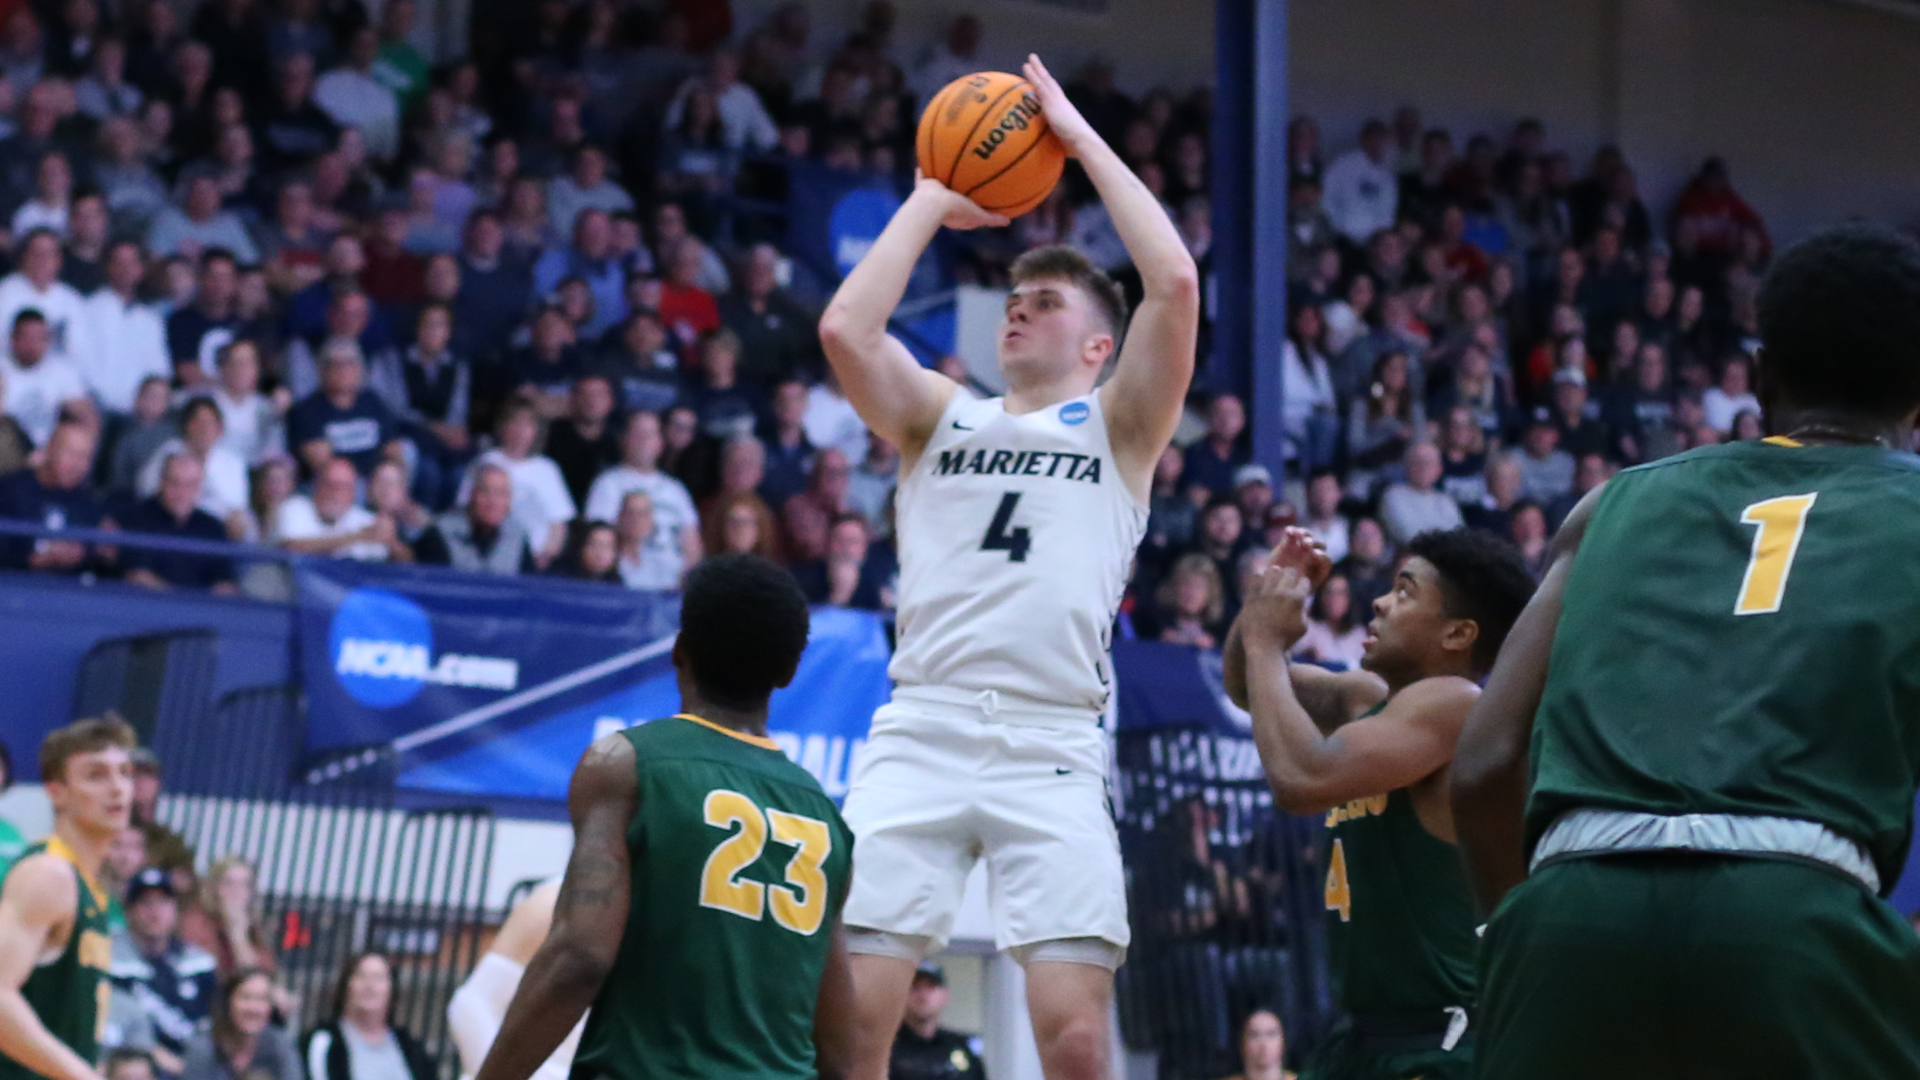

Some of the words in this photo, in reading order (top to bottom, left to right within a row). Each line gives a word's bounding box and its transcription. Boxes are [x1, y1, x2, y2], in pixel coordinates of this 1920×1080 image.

[931, 449, 1101, 484] MARIETTA
[979, 490, 1031, 562] 4
[1733, 491, 1819, 615] 1
[699, 789, 832, 936] 23
